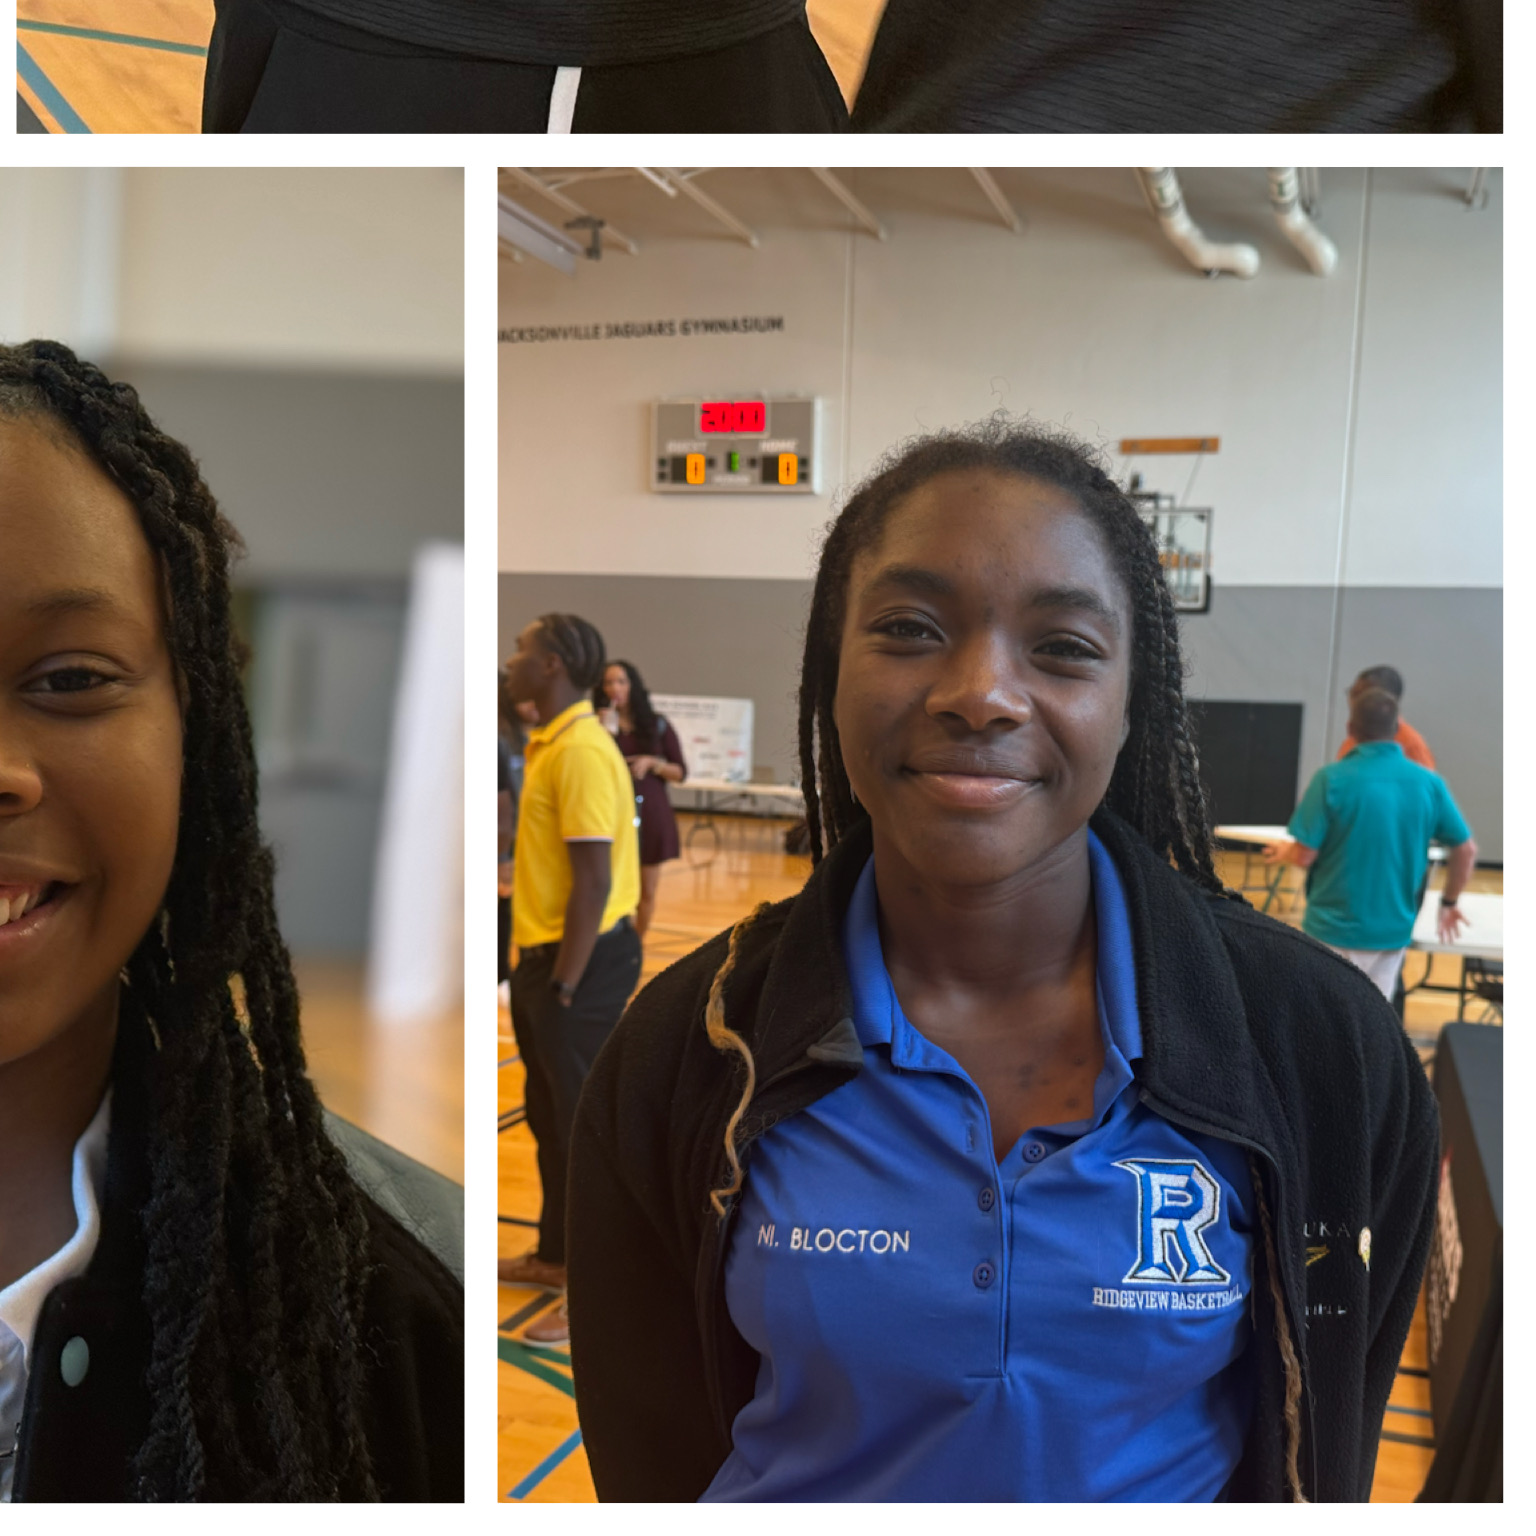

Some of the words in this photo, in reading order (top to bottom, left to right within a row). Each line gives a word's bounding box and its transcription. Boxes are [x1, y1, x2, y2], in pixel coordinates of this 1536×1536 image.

[606, 320, 676, 339] JAGUARS
[679, 316, 784, 336] GYMNASIUM
[1110, 1158, 1231, 1286] R
[790, 1227, 910, 1254] BLOCTON
[1092, 1287, 1170, 1310] RIDGEVIEW
